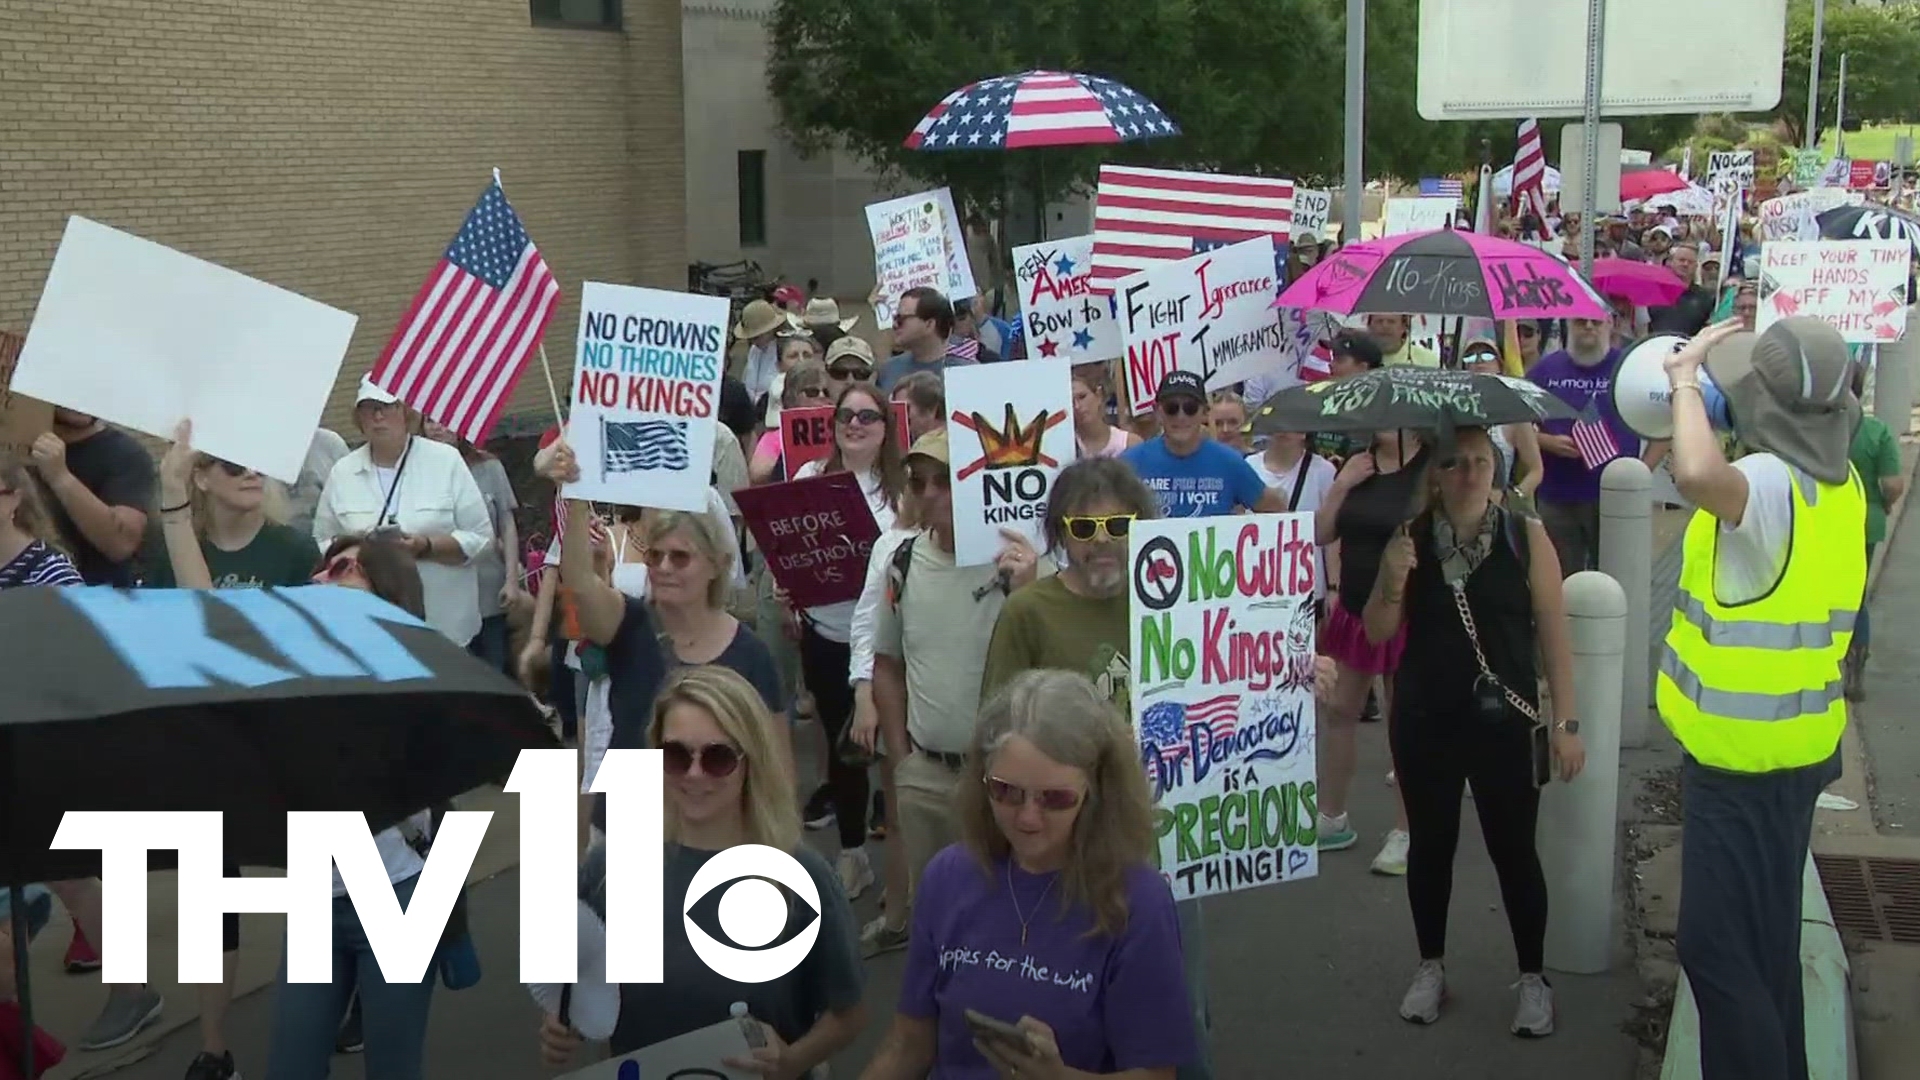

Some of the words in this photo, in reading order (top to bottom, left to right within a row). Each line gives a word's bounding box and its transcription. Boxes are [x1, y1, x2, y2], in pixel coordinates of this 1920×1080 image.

[1018, 249, 1057, 282] REAL
[1820, 249, 1857, 263] YOUR
[1871, 249, 1910, 262] TINY
[1386, 256, 1420, 295] No
[1488, 262, 1573, 310] Hate
[1812, 269, 1869, 284] HANDS
[1080, 298, 1102, 323] to
[1125, 281, 1191, 334] FIGHT
[1195, 259, 1272, 320] Ignorance
[1794, 288, 1830, 304] OFF
[1850, 288, 1881, 305] MY
[586, 311, 616, 340] NO
[623, 316, 720, 353] CROWNS
[582, 341, 612, 369] NO
[619, 345, 718, 382] THRONES
[1129, 332, 1181, 397] NOT
[579, 370, 619, 407] NO
[626, 375, 713, 418] KINGS
[982, 468, 1047, 506] NO
[1187, 492, 1219, 505] VOTE
[769, 510, 846, 536] BEFORE
[984, 502, 1048, 525] KINGS
[778, 534, 872, 570] DESTROYS
[802, 532, 819, 548] IT
[814, 566, 843, 583] US
[1188, 525, 1235, 602] No
[1235, 520, 1314, 598] Cults
[1139, 612, 1196, 684] No
[1201, 606, 1284, 691] Kings
[1190, 701, 1303, 784] Democracy
[1244, 765, 1259, 785] A
[1151, 781, 1318, 870] PRECIOUS
[939, 945, 981, 971] ippies
[984, 950, 1016, 972] for
[1020, 954, 1050, 981] the
